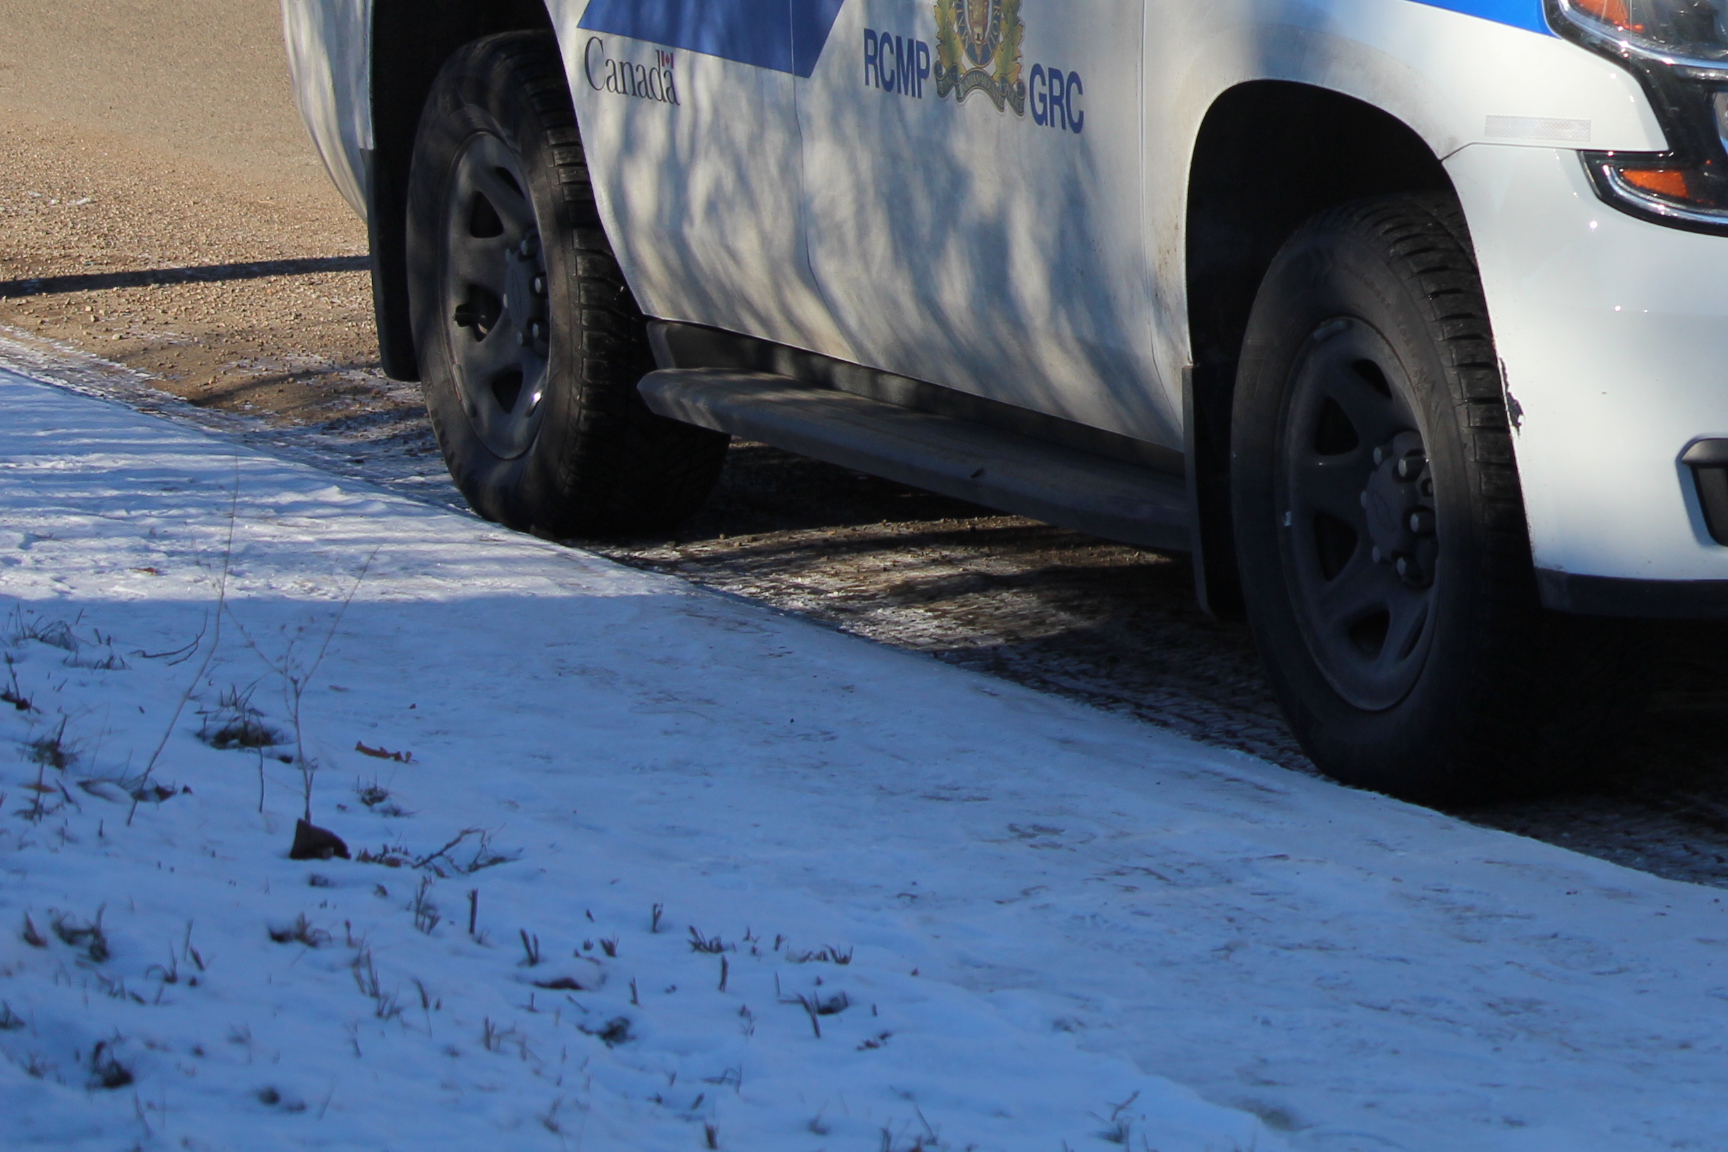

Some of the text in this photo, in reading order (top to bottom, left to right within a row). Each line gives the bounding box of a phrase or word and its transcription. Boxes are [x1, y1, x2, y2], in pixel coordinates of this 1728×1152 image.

[584, 35, 681, 106] Canada
[863, 28, 931, 99] RCMP
[1029, 63, 1084, 134] GRC
